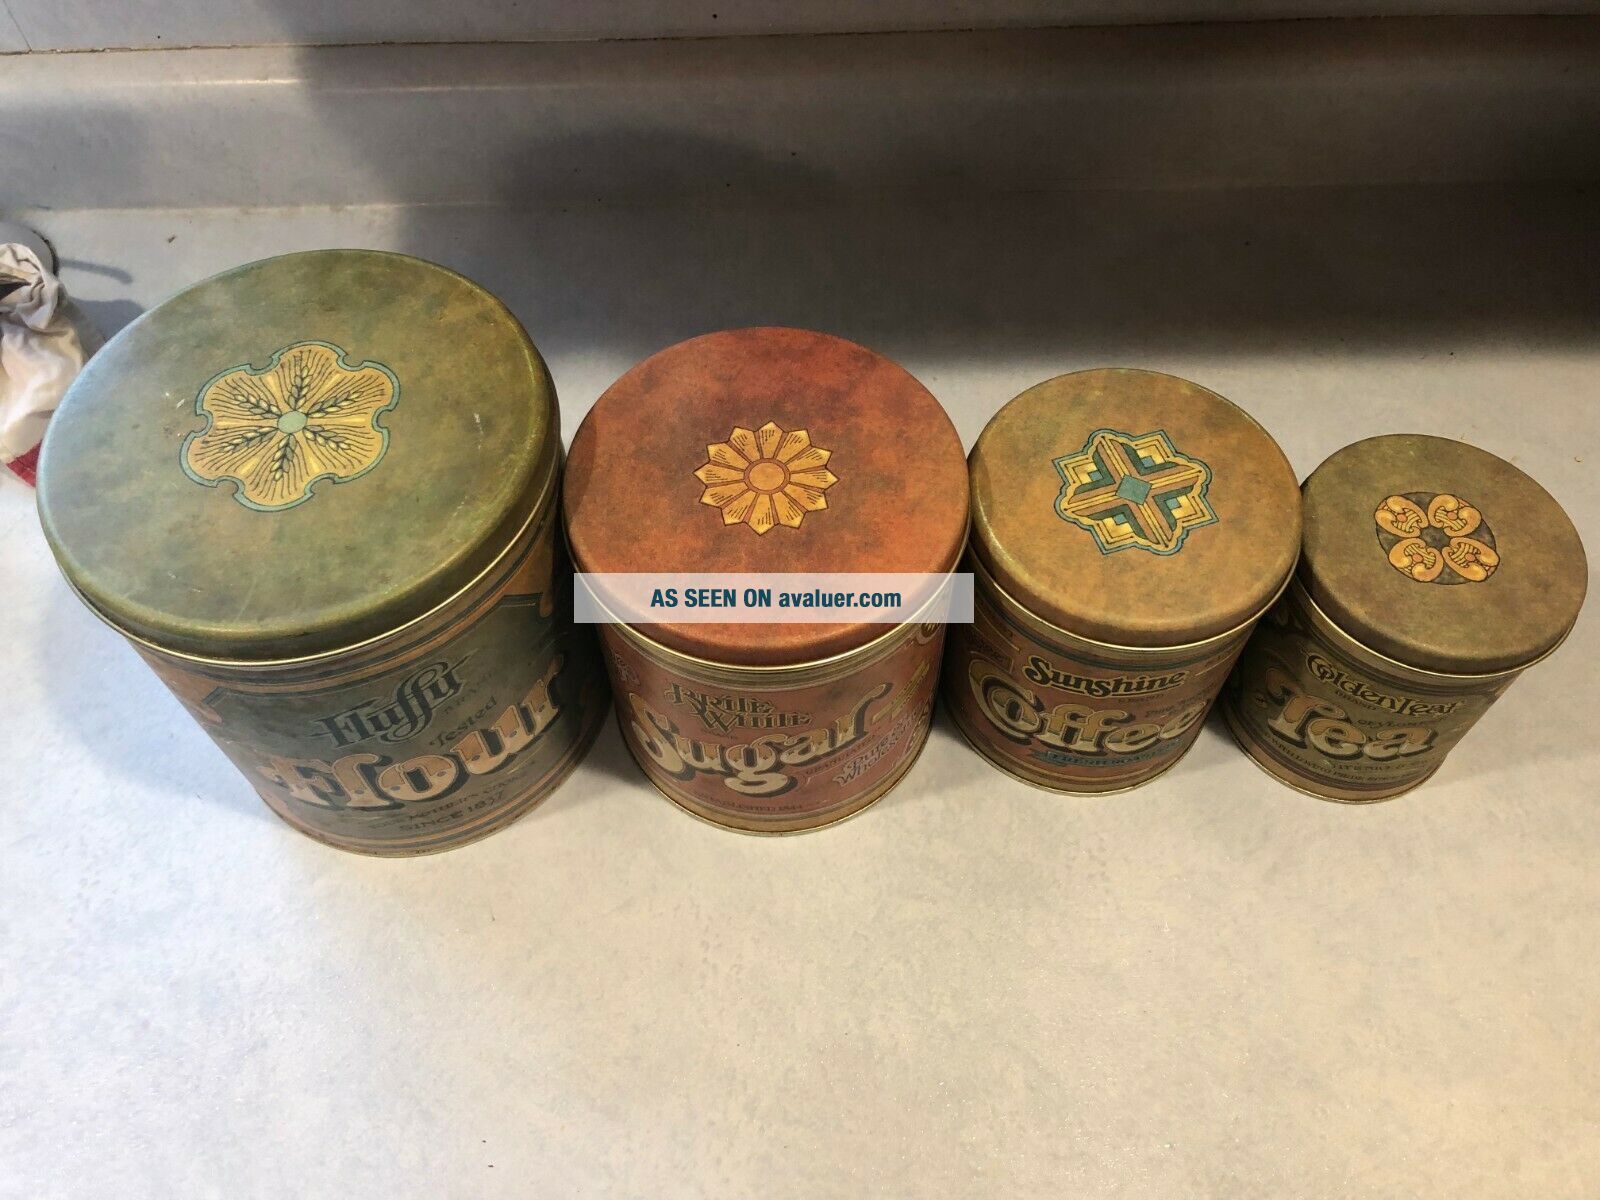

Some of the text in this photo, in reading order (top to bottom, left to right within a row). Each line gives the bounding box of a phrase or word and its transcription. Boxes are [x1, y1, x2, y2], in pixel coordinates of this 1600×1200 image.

[969, 659, 1208, 757] Coffee
[1022, 655, 1190, 698] Sunshine
[1266, 667, 1439, 762] Tea
[256, 654, 563, 810] Flour
[628, 682, 894, 798] Sugar
